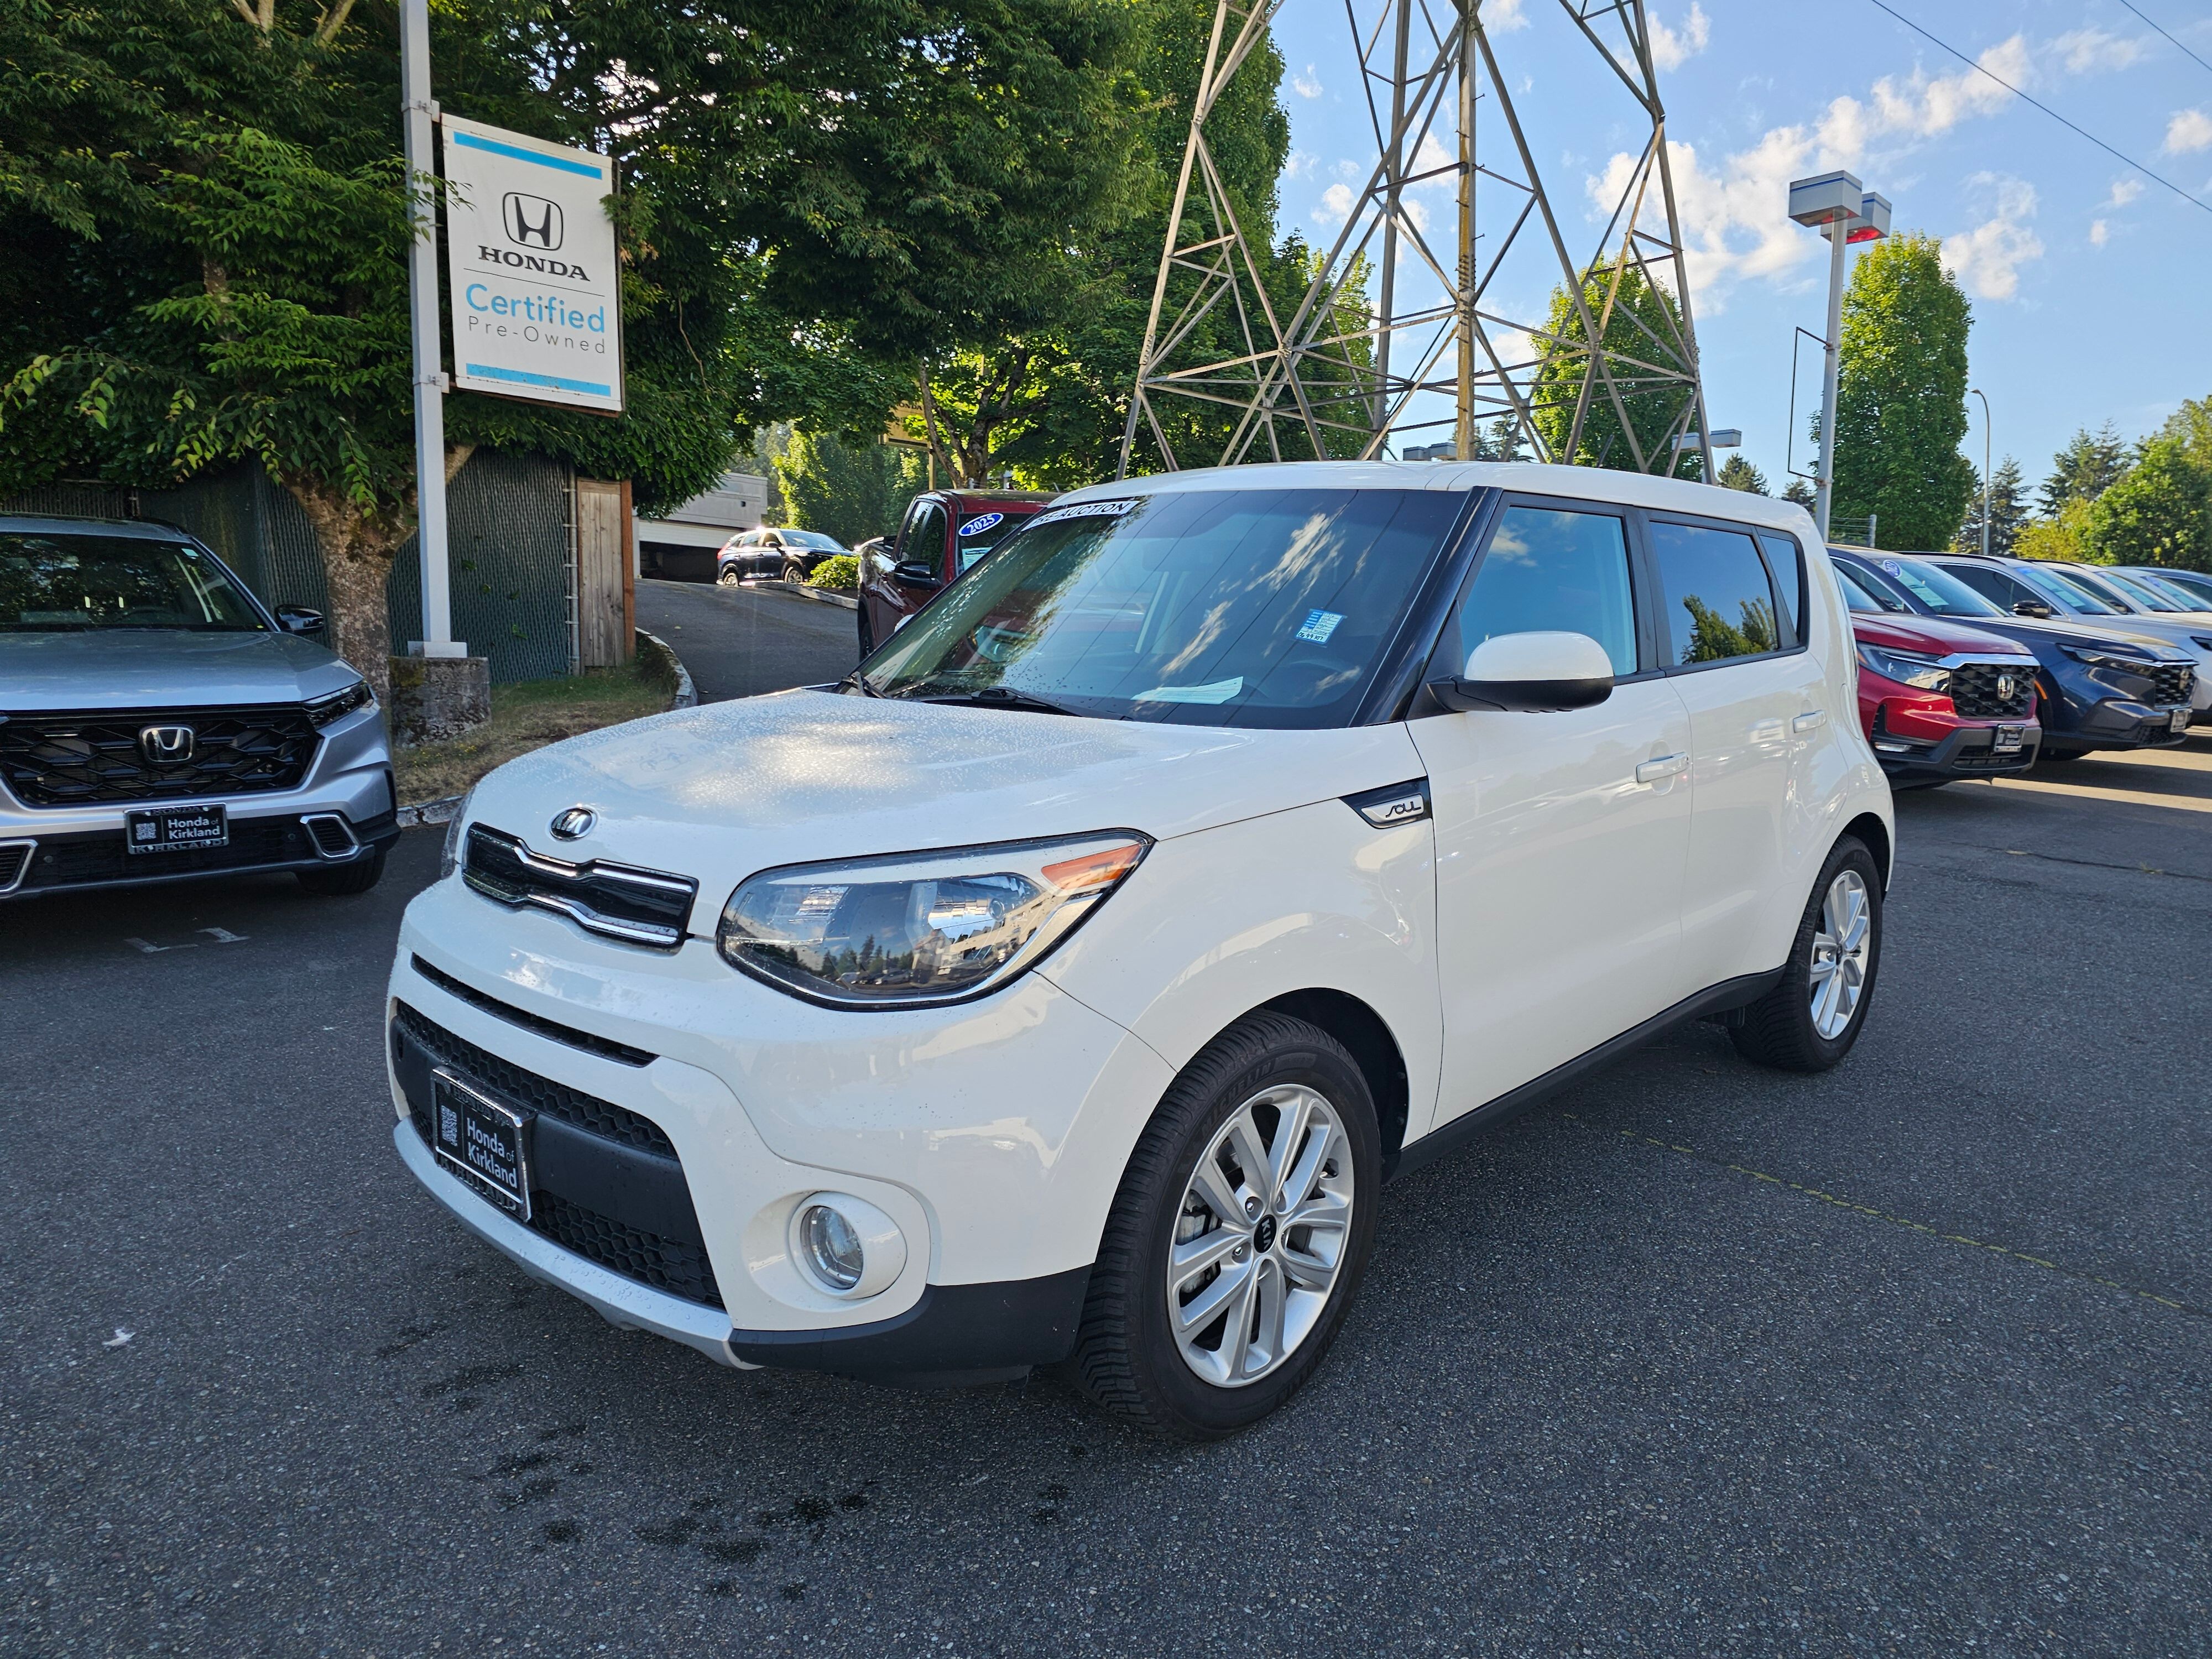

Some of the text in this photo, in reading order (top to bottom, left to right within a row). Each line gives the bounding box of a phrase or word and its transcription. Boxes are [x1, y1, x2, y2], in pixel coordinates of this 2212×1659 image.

[478, 245, 591, 282] HONDA
[466, 283, 605, 333] Certified
[468, 316, 605, 354] Pre-Owned
[898, 402, 922, 410] ONDA
[967, 515, 995, 534] 2025
[152, 807, 204, 816] HONDA
[1385, 801, 1421, 818] SOUL
[168, 816, 209, 828] Honda
[169, 826, 221, 839] Kirkland
[134, 839, 224, 854] KIRKLAND
[467, 1117, 515, 1164] Honda of
[468, 1141, 517, 1189] Kirkland
[1261, 1218, 1271, 1250] KIA
